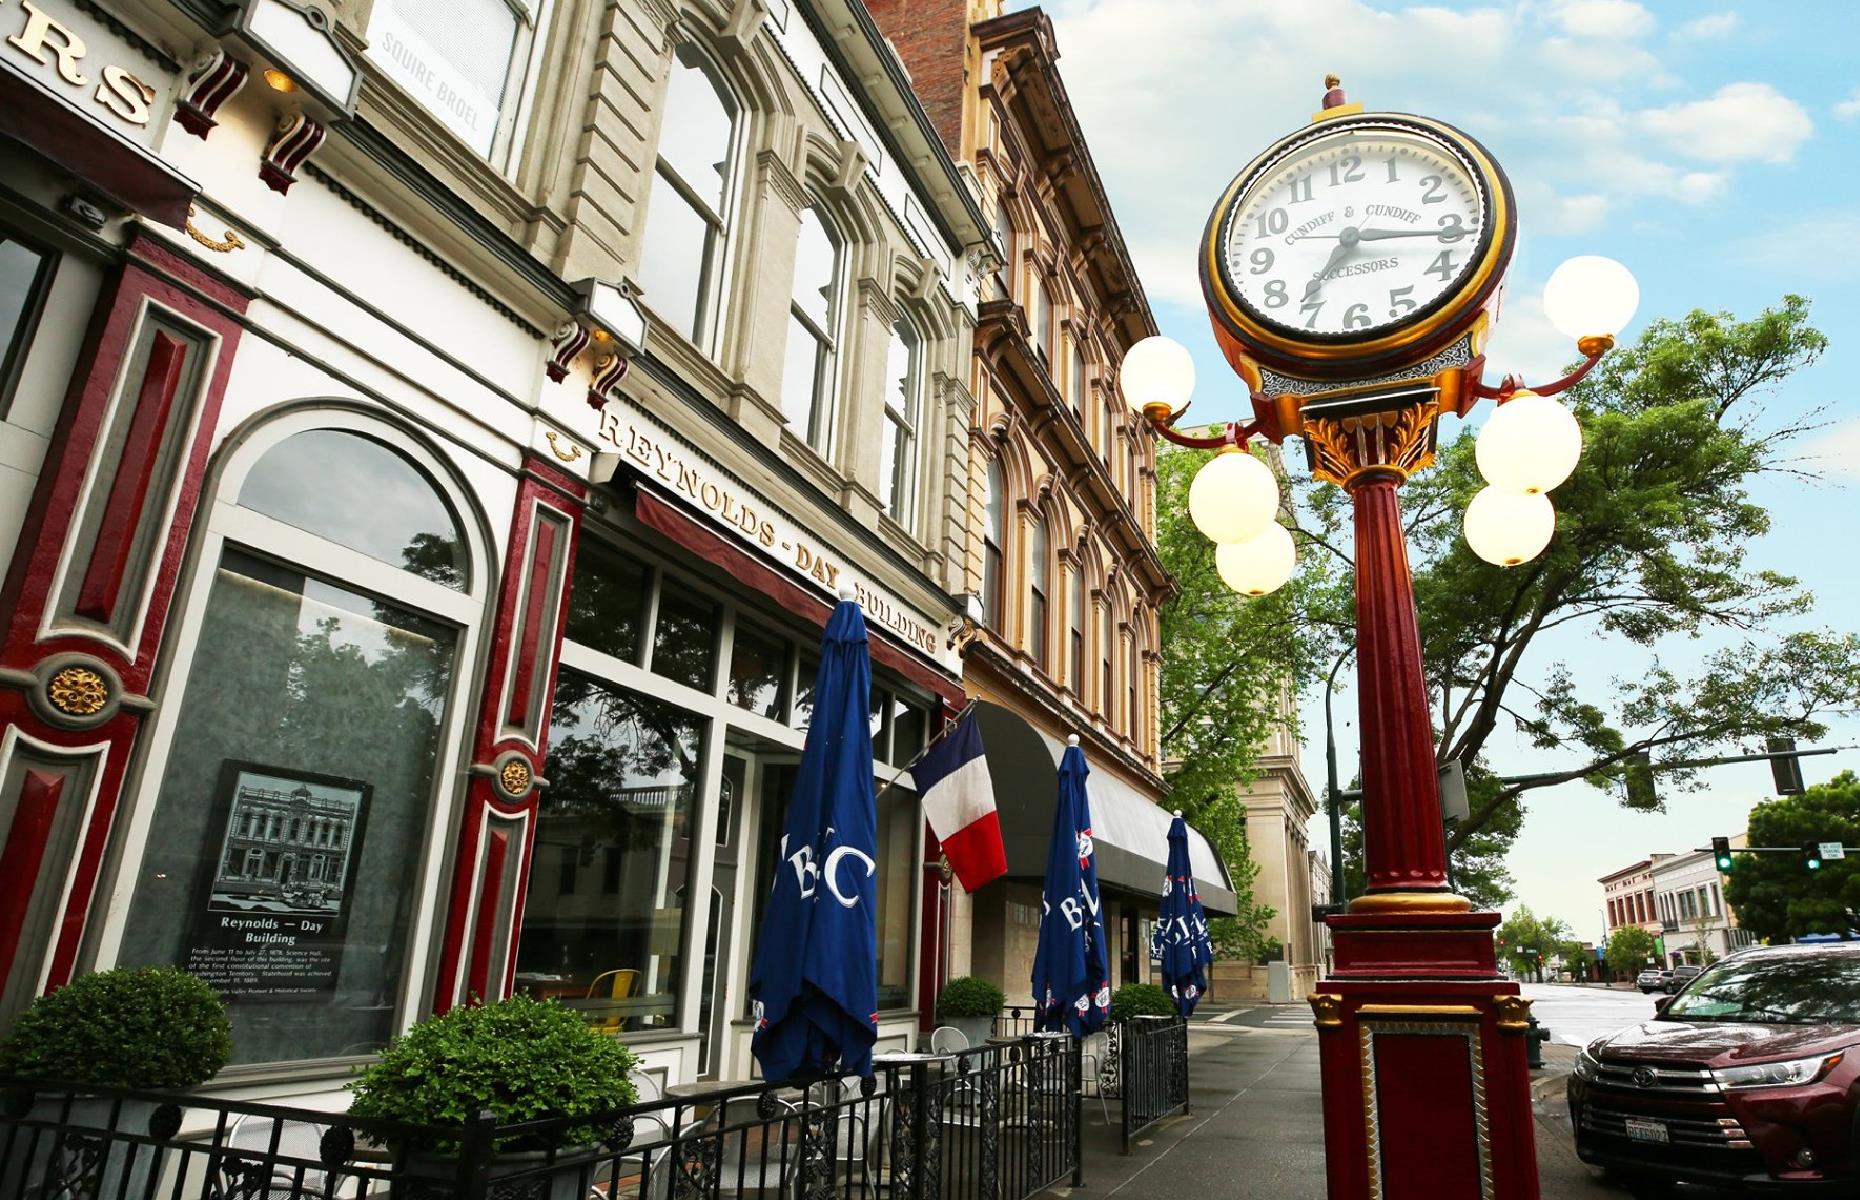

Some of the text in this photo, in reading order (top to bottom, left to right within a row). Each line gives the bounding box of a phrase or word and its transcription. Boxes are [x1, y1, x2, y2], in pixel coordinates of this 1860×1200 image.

[382, 31, 479, 132] SQUIRE BROEL
[1328, 155, 1366, 187] 12
[1382, 155, 1401, 184] 1
[1287, 174, 1315, 205] 11
[1419, 175, 1448, 205] 2
[1253, 207, 1289, 239] 10
[1284, 204, 1422, 246] CUNDIFF & CUNDIFF
[1249, 247, 1275, 275] 9
[1423, 248, 1459, 281] 4
[1263, 279, 1290, 309] 8
[1389, 284, 1417, 318] 5
[1299, 300, 1328, 328] 7
[1343, 303, 1372, 329] 6
[599, 408, 776, 547] REYNOLDS
[795, 543, 840, 590] DAY
[854, 582, 937, 654] BUILDING
[221, 917, 279, 931] Reynolds
[301, 920, 324, 933] Day
[245, 933, 296, 946] Building
